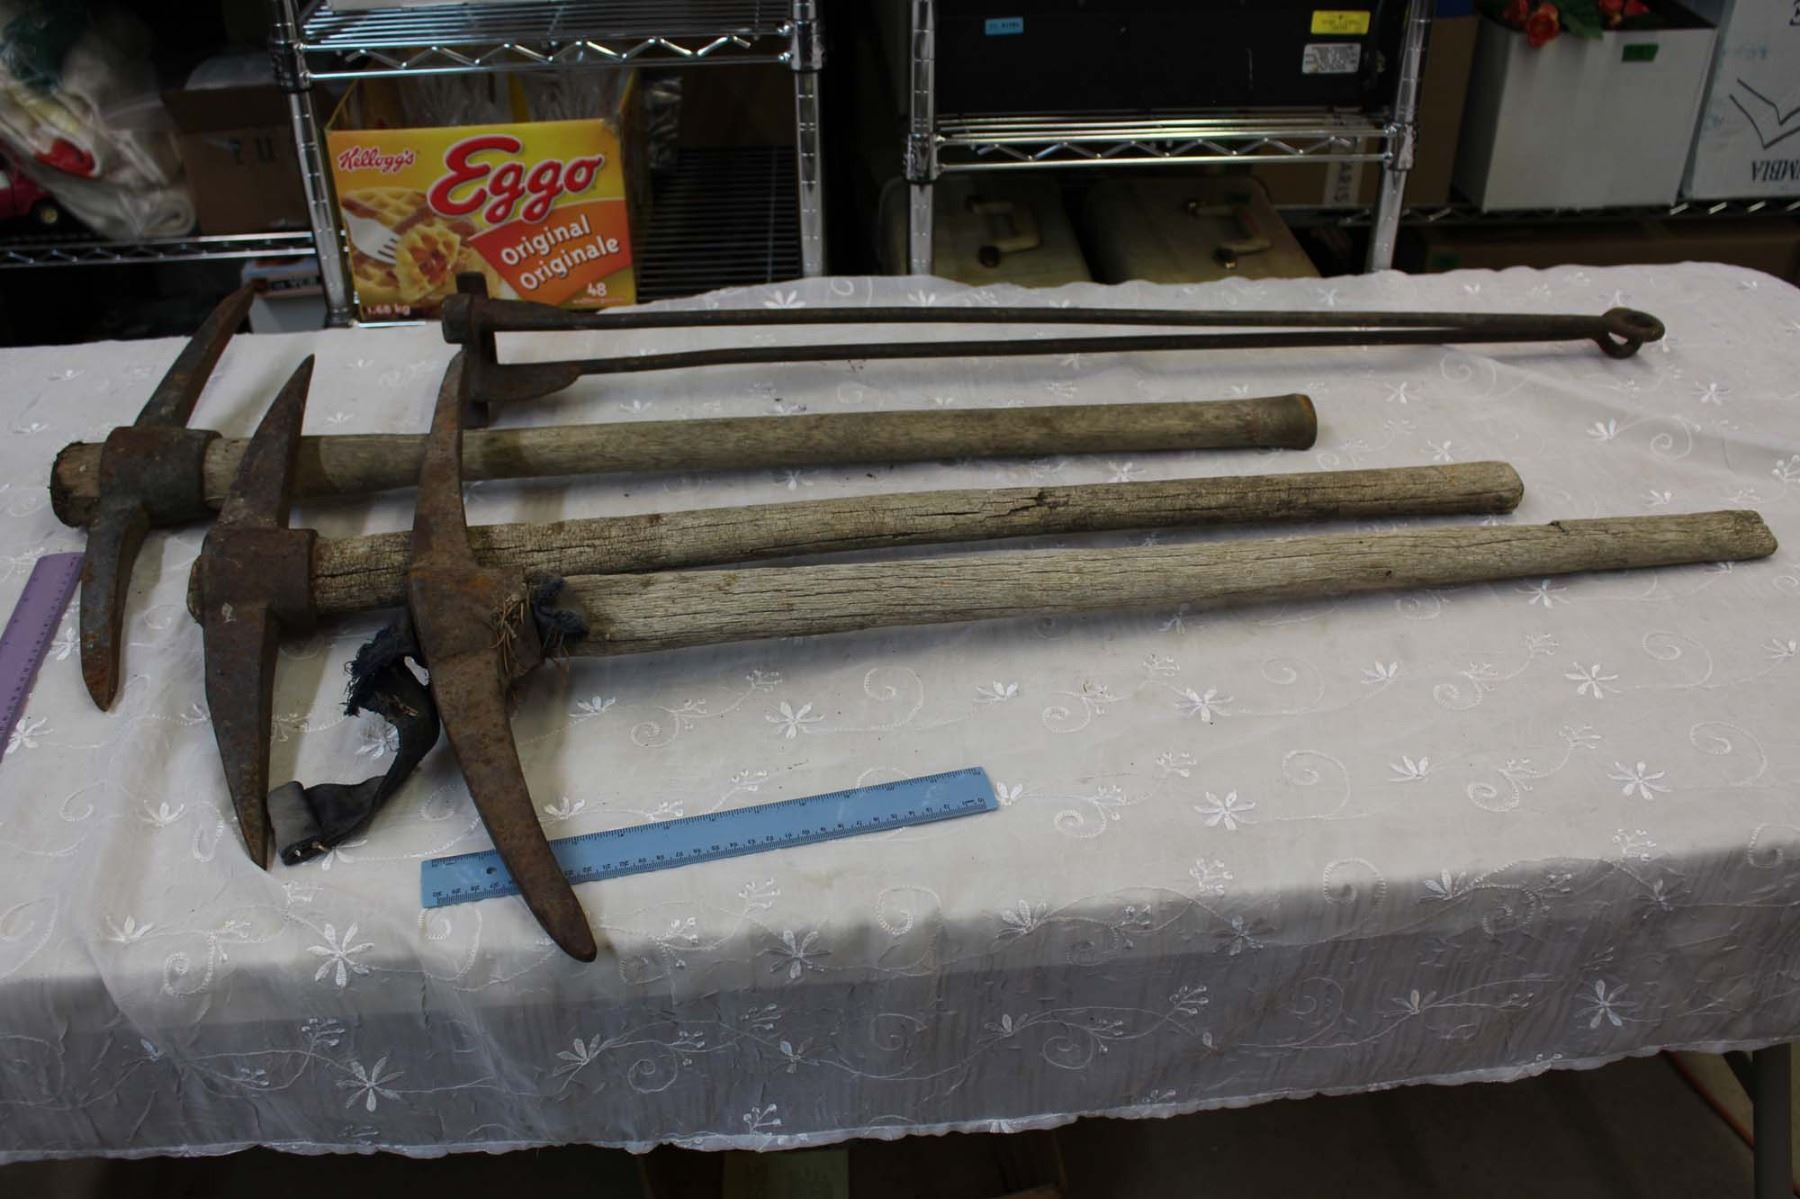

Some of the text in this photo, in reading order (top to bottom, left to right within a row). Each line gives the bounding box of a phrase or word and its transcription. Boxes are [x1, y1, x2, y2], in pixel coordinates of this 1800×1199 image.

[338, 147, 416, 172] Kellogg's
[427, 135, 604, 225] Eggo
[501, 213, 591, 266] Original
[520, 236, 620, 291] Originale
[586, 281, 607, 297] 48
[394, 303, 411, 316] kg
